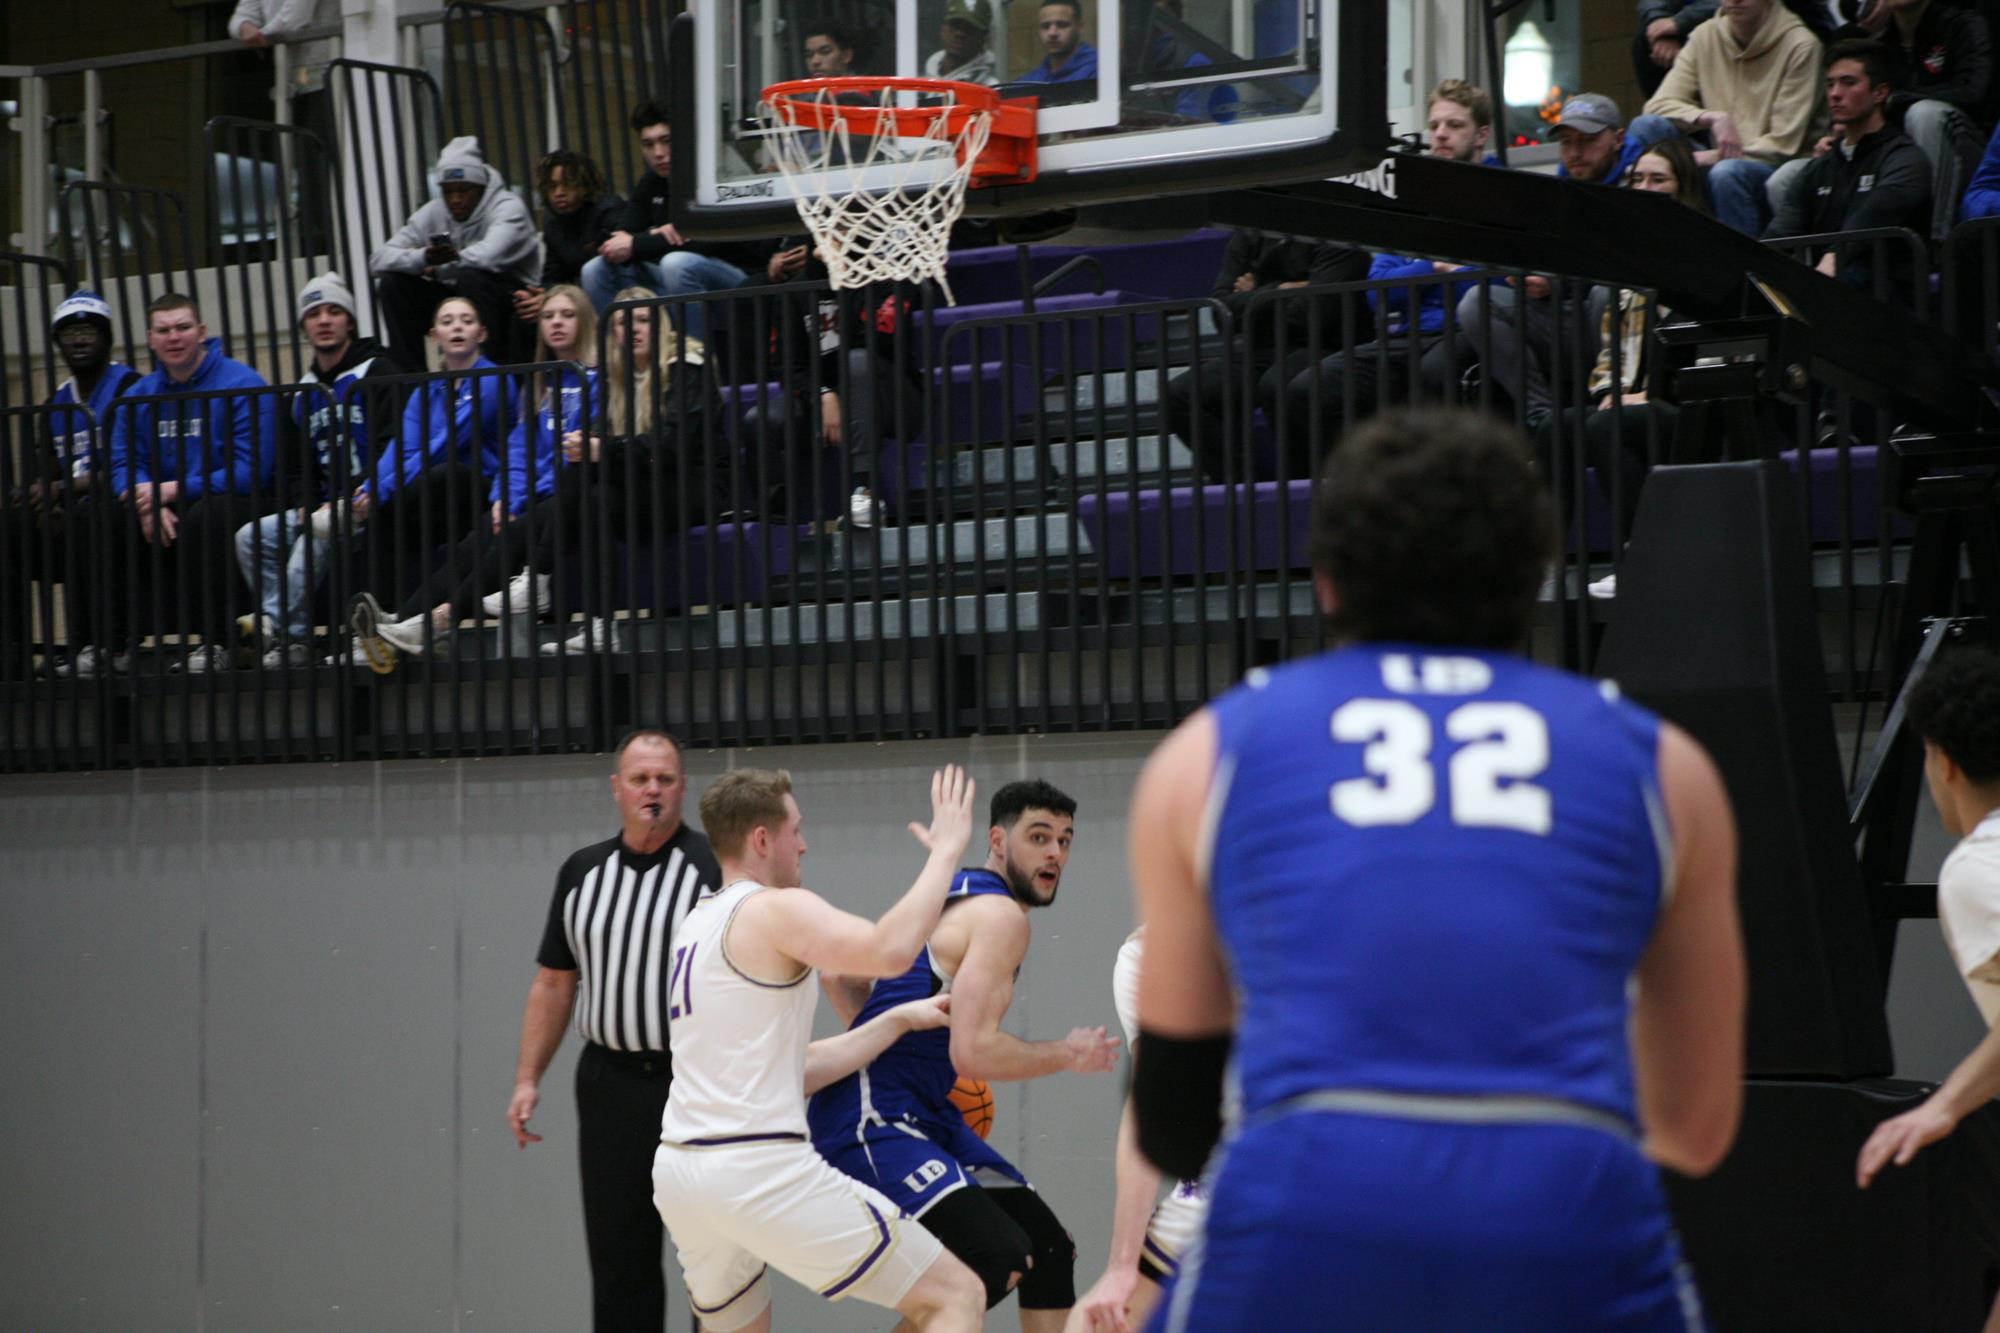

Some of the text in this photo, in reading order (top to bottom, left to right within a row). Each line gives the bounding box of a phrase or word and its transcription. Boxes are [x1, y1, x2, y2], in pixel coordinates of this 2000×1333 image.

[716, 180, 774, 203] SPALDING
[1329, 698, 1553, 836] 32
[670, 942, 698, 1020] 21
